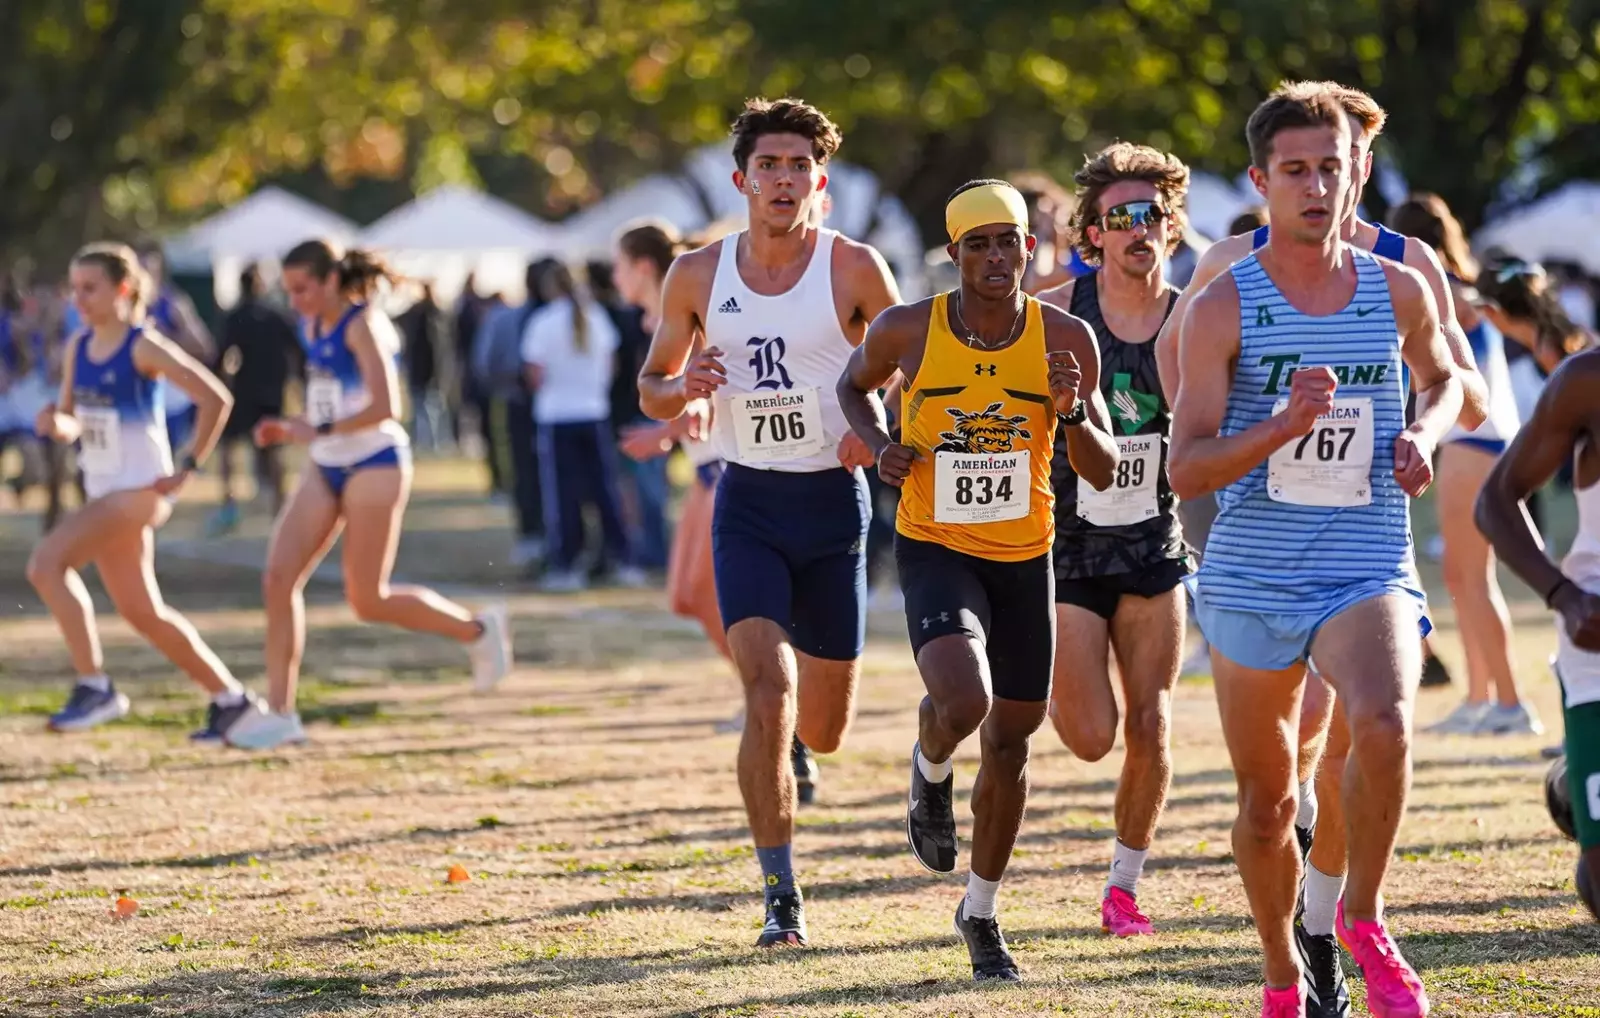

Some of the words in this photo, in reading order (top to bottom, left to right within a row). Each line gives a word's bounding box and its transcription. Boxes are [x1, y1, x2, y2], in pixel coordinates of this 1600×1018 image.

[1256, 304, 1275, 327] A
[746, 336, 794, 391] R
[746, 395, 804, 409] AMERICAN
[751, 411, 806, 444] 706
[1294, 427, 1356, 462] 767
[952, 457, 1017, 470] AMERICAN
[956, 476, 1013, 505] 834
